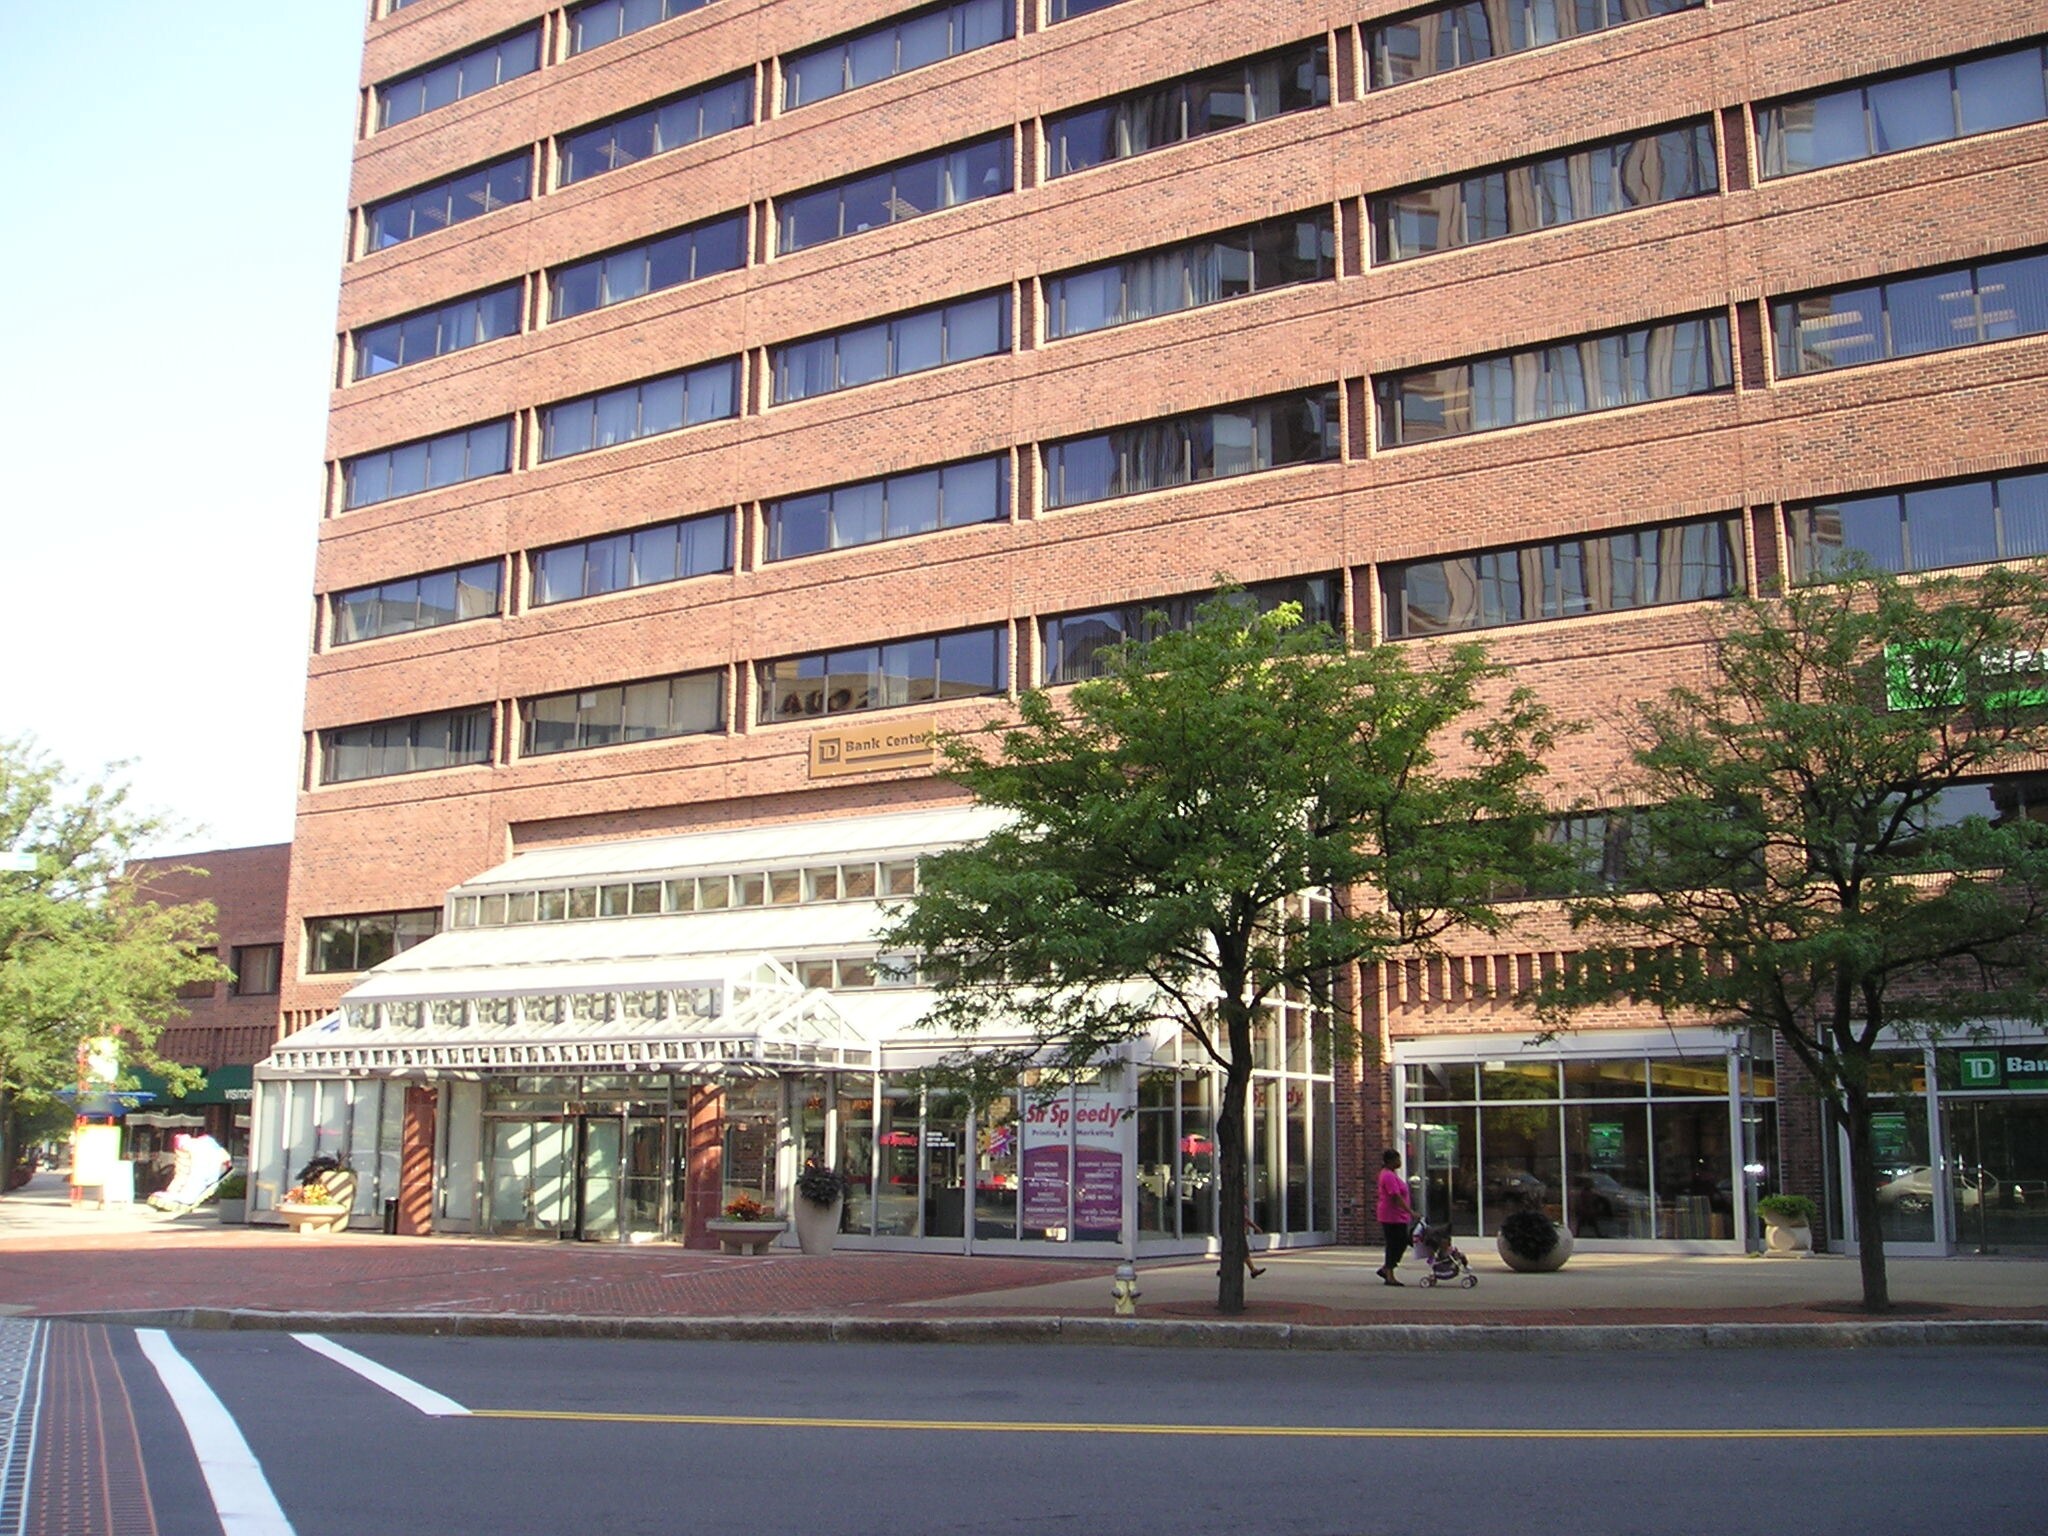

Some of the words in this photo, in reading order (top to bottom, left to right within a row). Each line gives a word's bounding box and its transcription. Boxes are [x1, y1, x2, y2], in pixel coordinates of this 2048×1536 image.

[845, 737, 880, 752] Bank
[1964, 1057, 1996, 1079] TD
[1049, 1102, 1121, 1128] Speedy
[1032, 1130, 1060, 1138] Printing
[1076, 1130, 1115, 1138] Marketing
